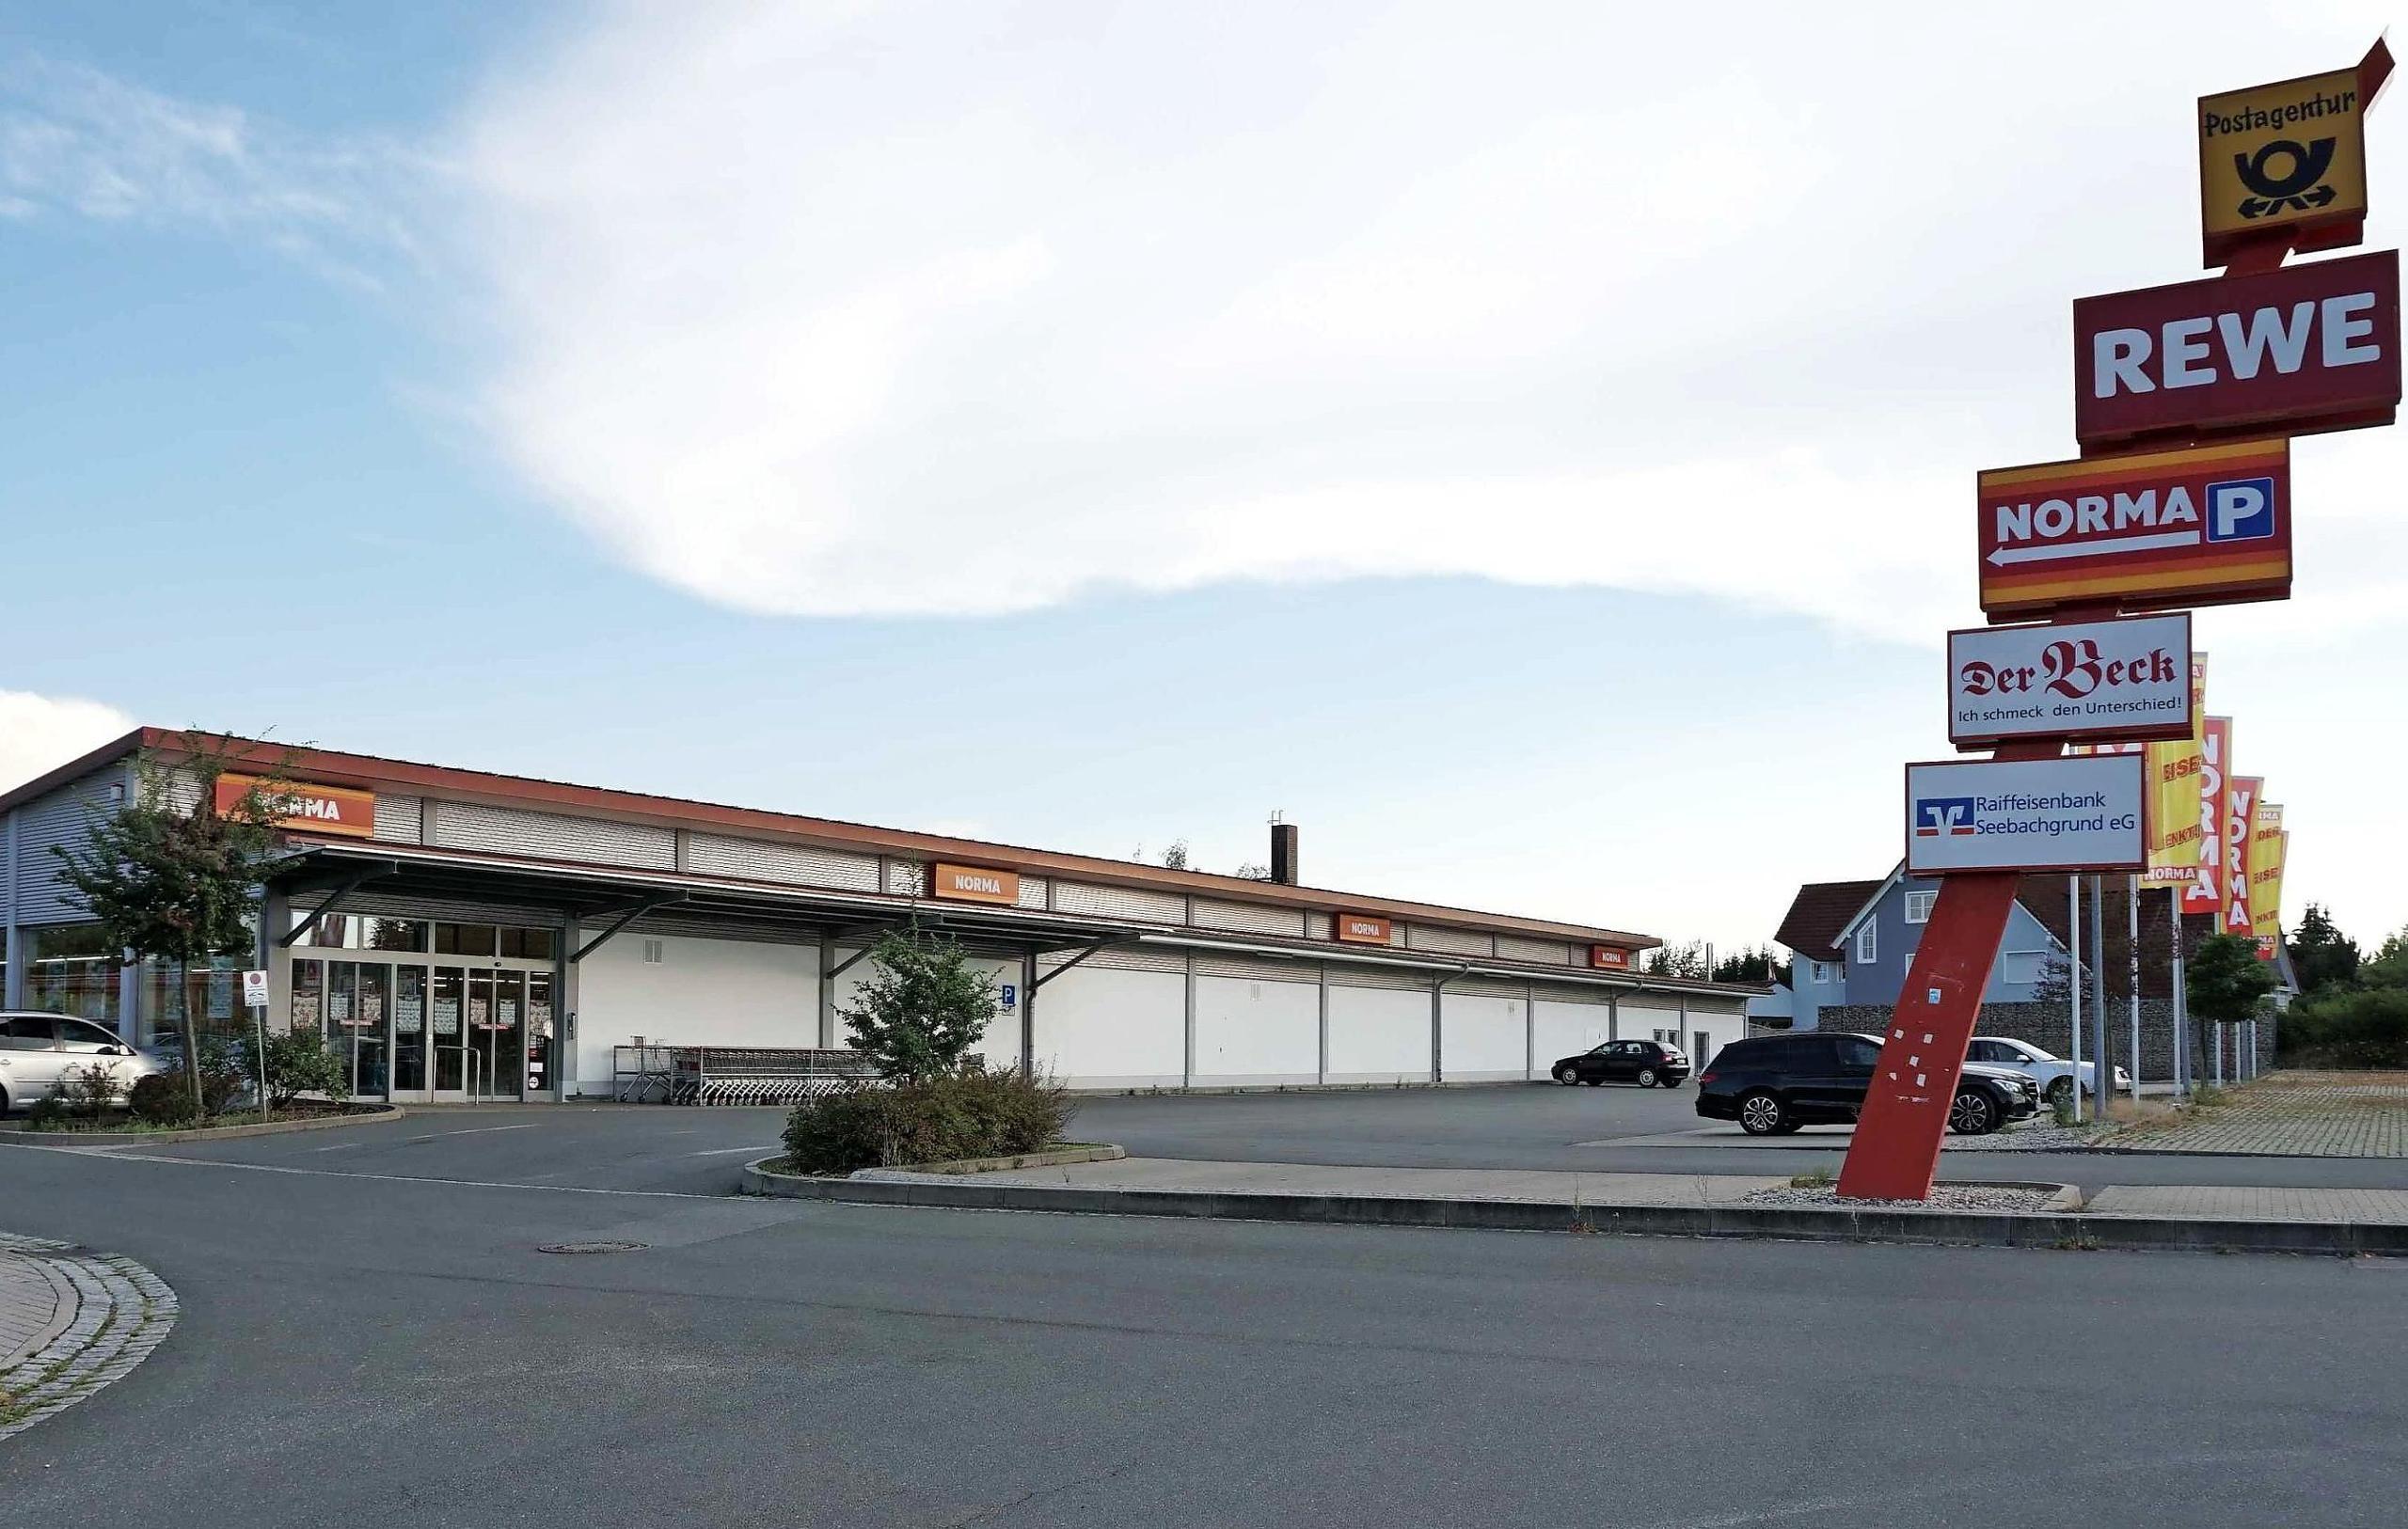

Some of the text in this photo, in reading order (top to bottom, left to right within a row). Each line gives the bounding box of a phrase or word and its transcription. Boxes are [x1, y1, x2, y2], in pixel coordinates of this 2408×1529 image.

[2205, 91, 2355, 137] Postagentur
[2094, 292, 2381, 398] REWE
[1996, 486, 2264, 543] NORMA P
[1961, 639, 2178, 699] Der Beck
[1958, 709, 1978, 722] Ich
[1983, 705, 2043, 720] schmeck
[2052, 703, 2081, 717] den
[2085, 697, 2182, 714] Unterschied!
[1976, 791, 2106, 812] Raiffeisenbank
[1976, 813, 2135, 836] Seebachgrund eG
[955, 875, 1001, 893] NORMA
[2145, 867, 2196, 881] NORMA
[1352, 922, 1380, 937] NORMA
